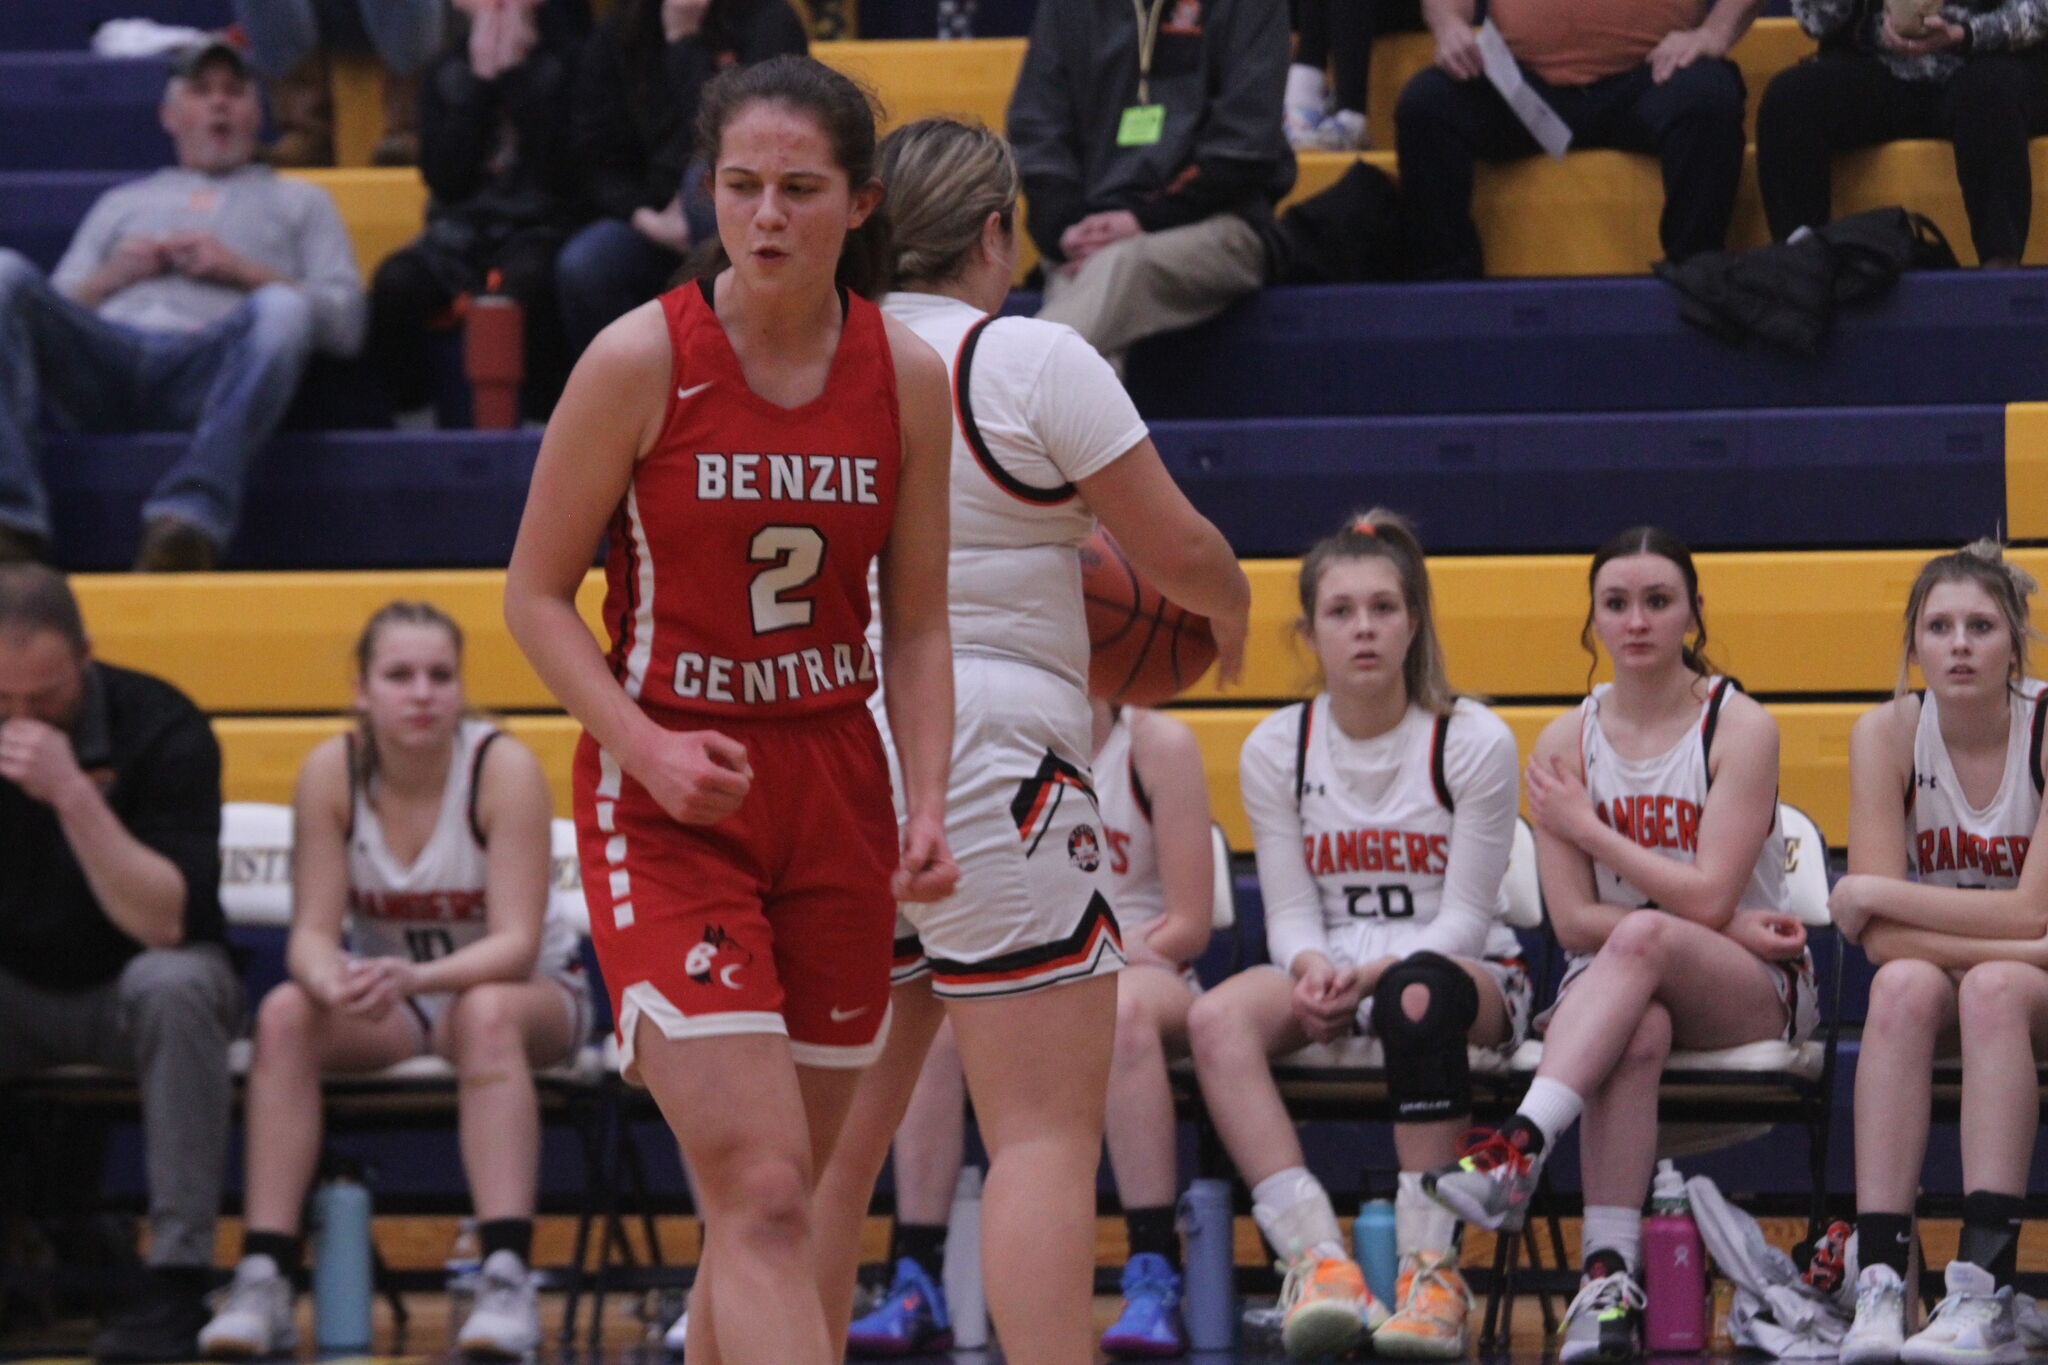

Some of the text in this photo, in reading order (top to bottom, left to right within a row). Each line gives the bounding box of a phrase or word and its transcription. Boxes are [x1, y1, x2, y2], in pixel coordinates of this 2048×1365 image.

[695, 453, 879, 504] BENZIE
[749, 523, 828, 635] 2
[673, 643, 875, 703] CENTRAL
[1303, 829, 1449, 877] RANGERS
